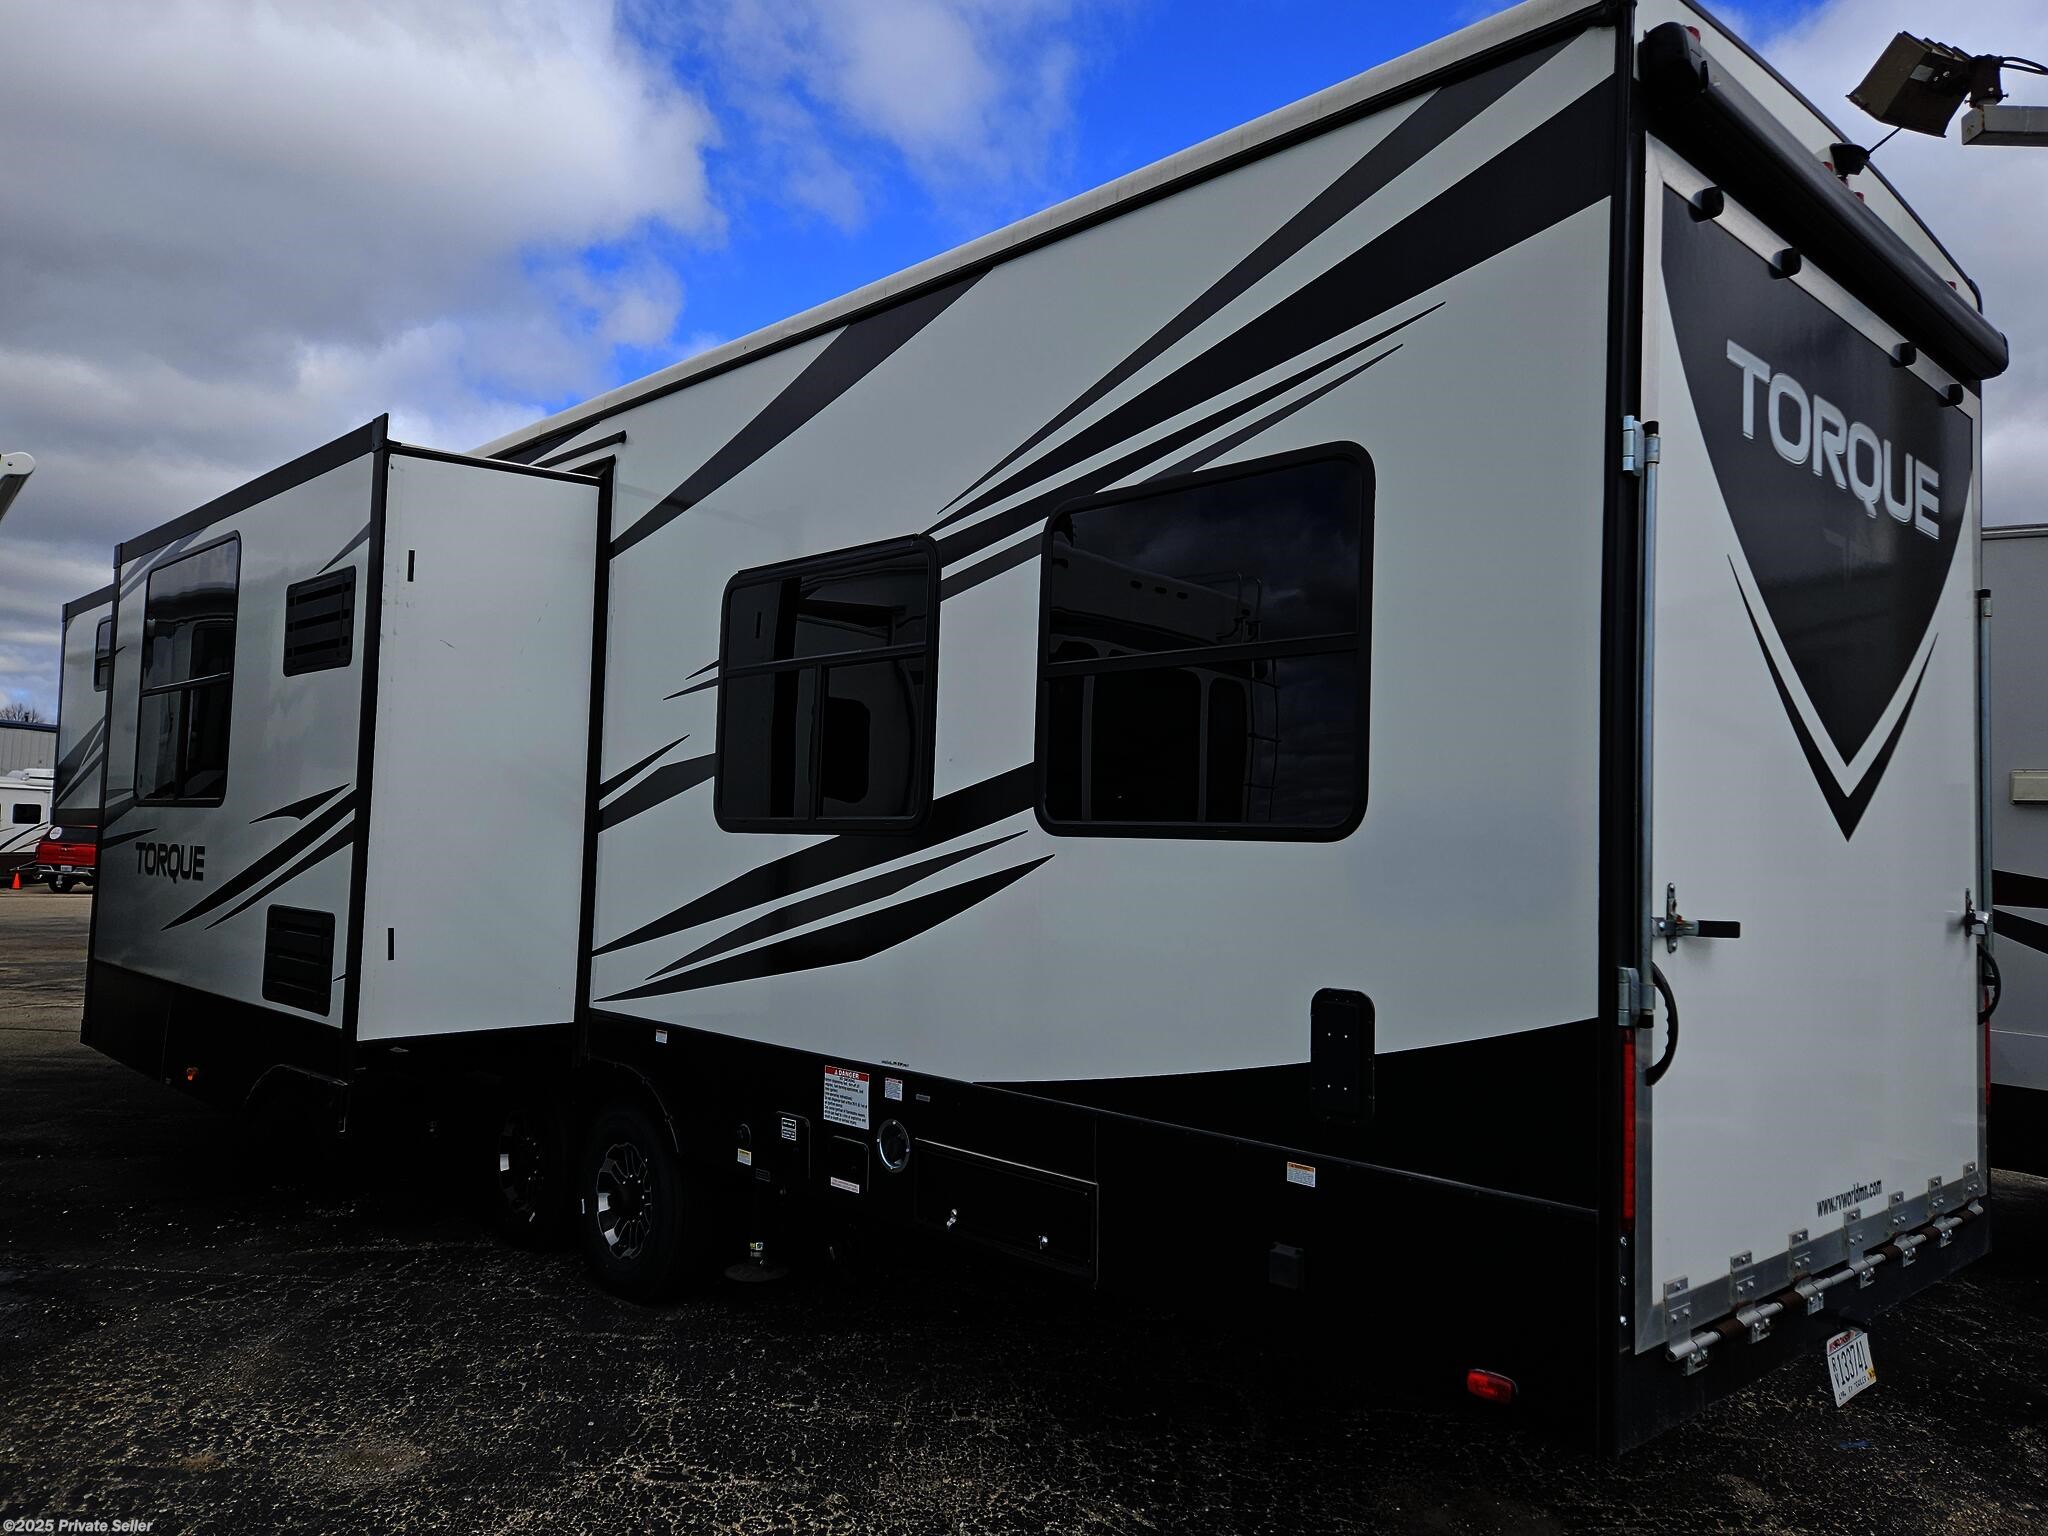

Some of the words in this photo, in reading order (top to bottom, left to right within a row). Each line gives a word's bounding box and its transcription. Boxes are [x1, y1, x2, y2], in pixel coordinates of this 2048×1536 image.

[1726, 338, 1940, 540] TORQUE
[135, 842, 206, 884] TORQUE
[838, 1069, 860, 1080] DANGER
[1836, 1340, 1868, 1386] 133741
